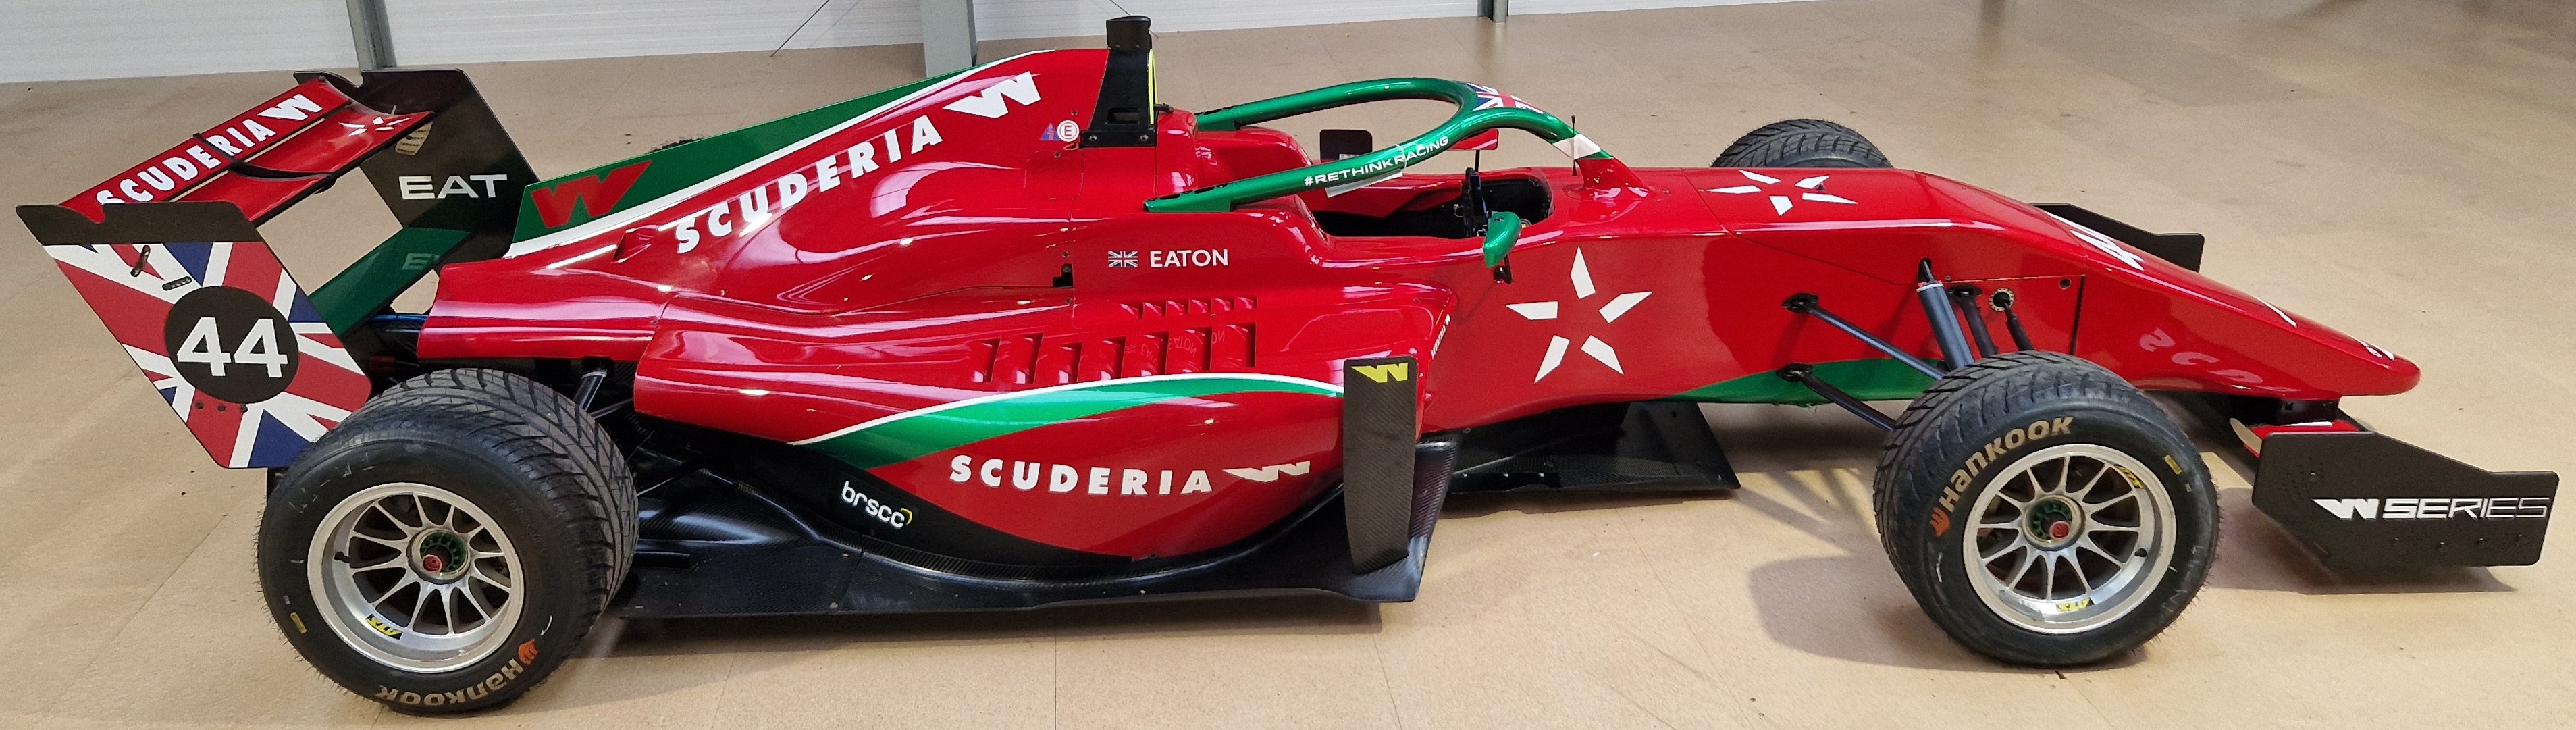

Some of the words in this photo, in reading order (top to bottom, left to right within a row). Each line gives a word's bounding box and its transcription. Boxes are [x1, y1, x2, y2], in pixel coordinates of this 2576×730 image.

[1064, 125, 1073, 137] E
[398, 174, 508, 199] EAT
[675, 114, 943, 254] SCUDERIA
[1150, 249, 1229, 268] EATON
[176, 317, 289, 378] 44
[949, 454, 1213, 495] SCUDERIA
[841, 480, 905, 529] brscc
[2382, 498, 2550, 519] SERIES
